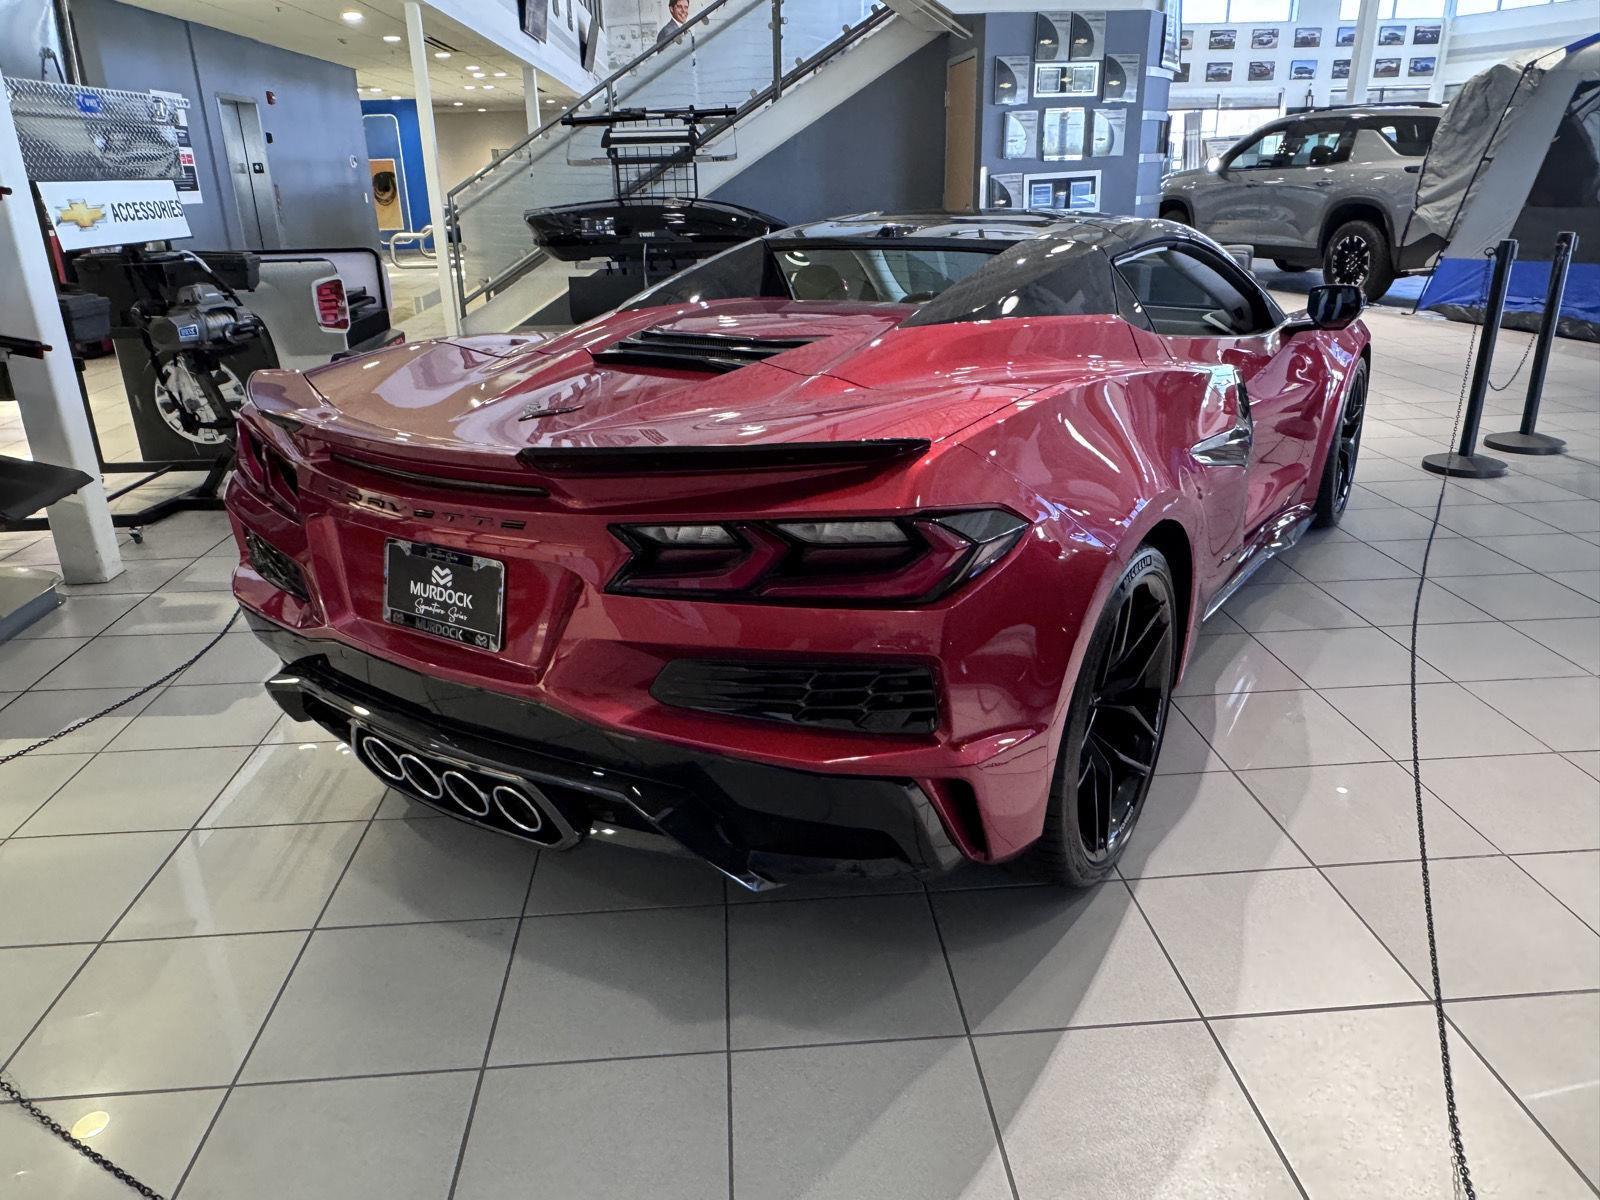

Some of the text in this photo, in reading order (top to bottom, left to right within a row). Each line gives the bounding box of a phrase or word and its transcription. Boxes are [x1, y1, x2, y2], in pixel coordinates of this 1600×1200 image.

[110, 199, 184, 222] ACCESSORIES
[1119, 554, 1153, 592] MICHELIN
[410, 580, 473, 609] MURDOCK
[415, 598, 468, 622] Signature Series
[415, 619, 463, 640] MURDOCK
